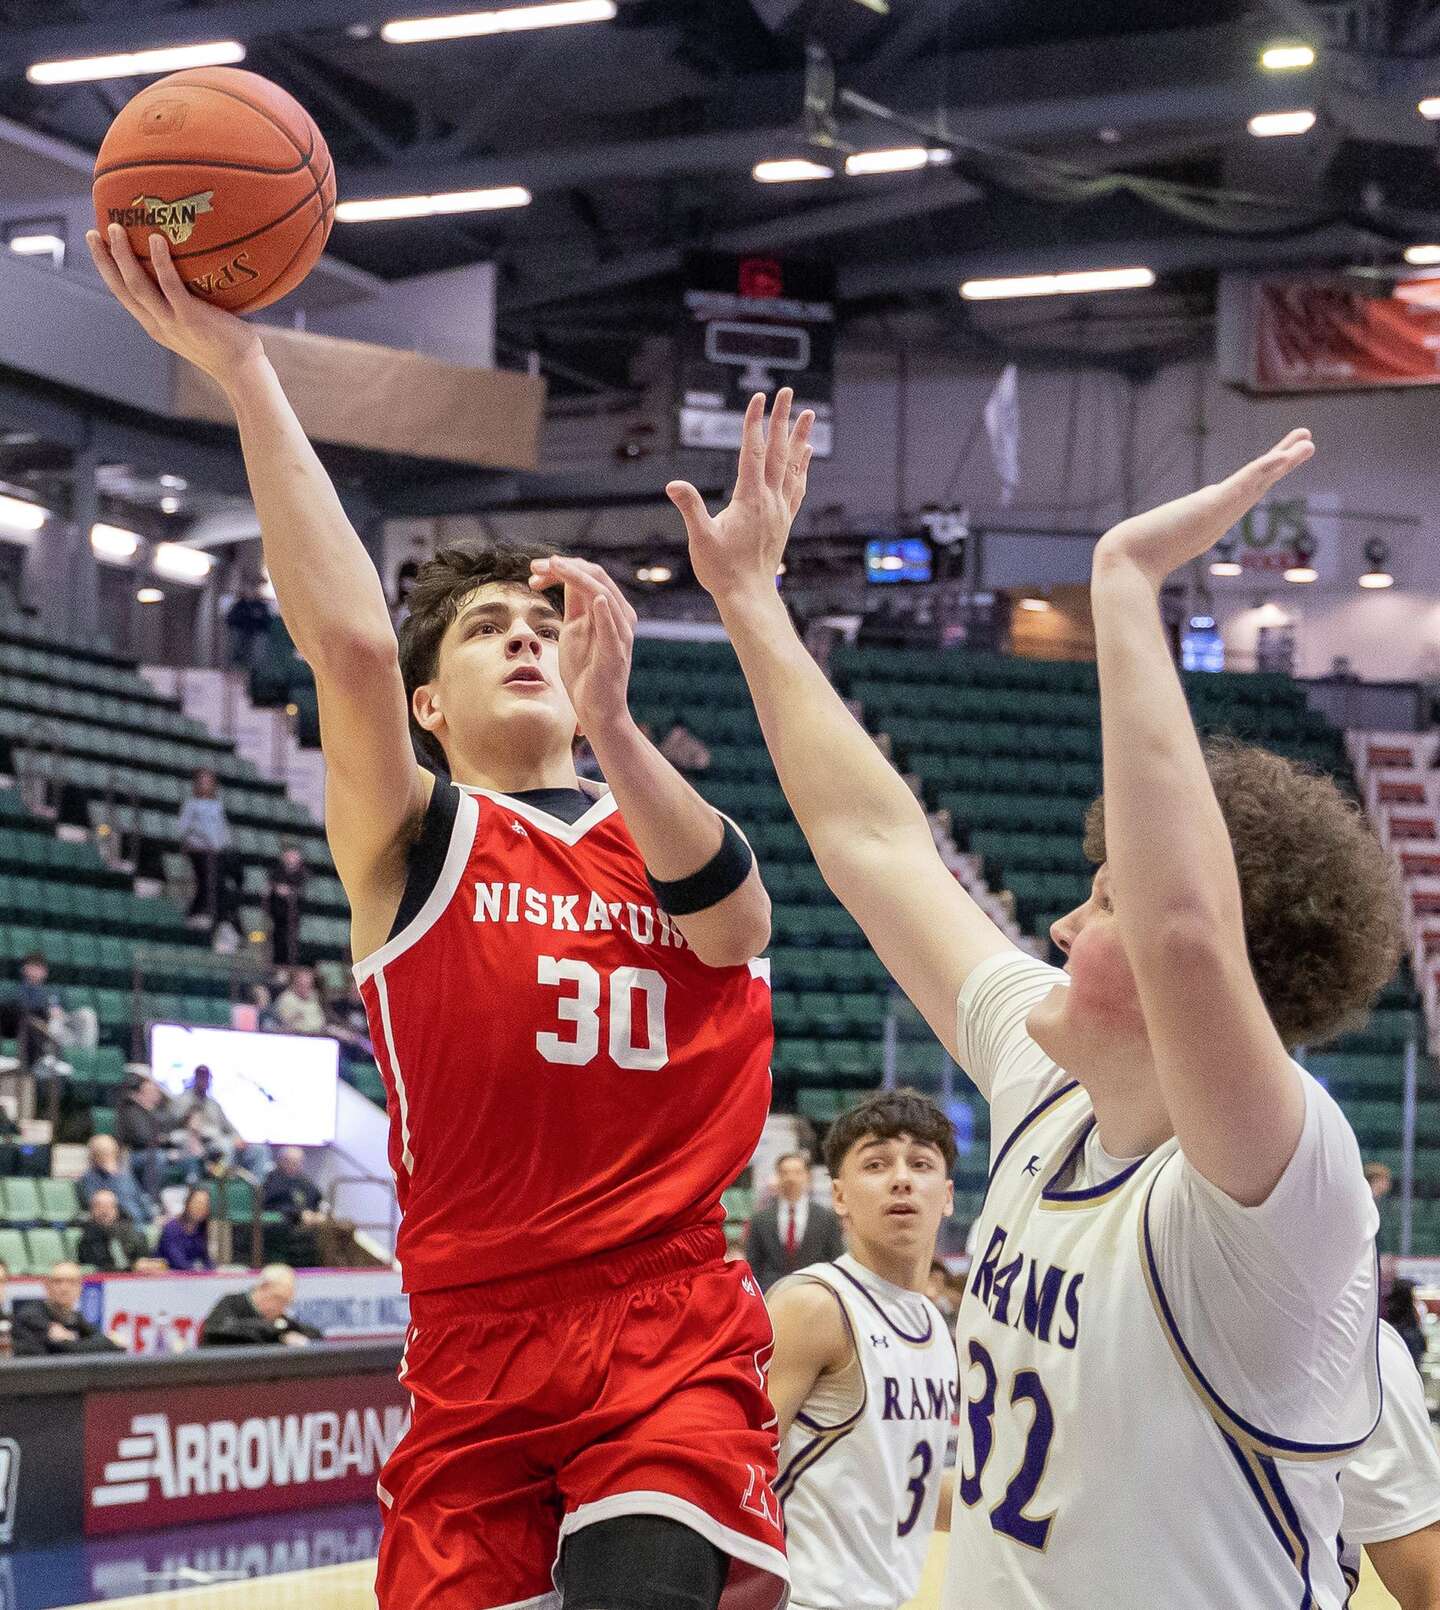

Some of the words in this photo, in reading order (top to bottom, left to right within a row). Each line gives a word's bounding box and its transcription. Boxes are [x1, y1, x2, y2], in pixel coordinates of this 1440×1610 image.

[536, 955, 669, 1071] 30
[971, 1224, 1085, 1350] RAMS
[897, 1440, 933, 1538] 3
[959, 1337, 1059, 1554] 32
